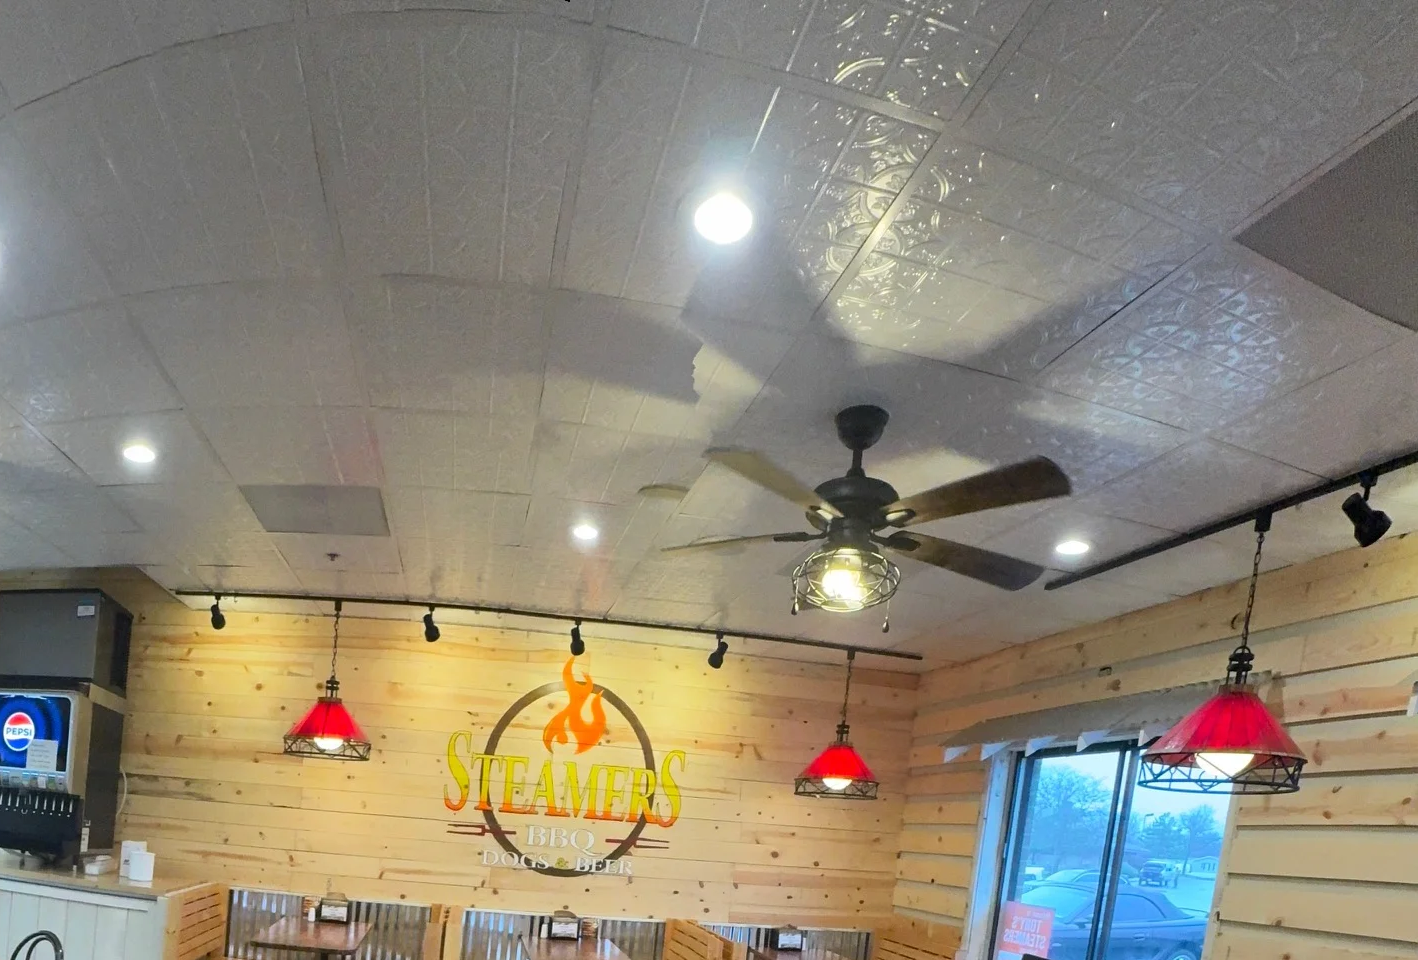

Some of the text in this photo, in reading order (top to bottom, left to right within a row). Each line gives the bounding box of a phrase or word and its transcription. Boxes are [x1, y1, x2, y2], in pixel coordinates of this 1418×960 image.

[6, 727, 33, 737] PEPSI
[443, 729, 687, 829] STEAMERS
[526, 824, 604, 857] BBQ
[480, 849, 634, 876] DOGS & BEER
